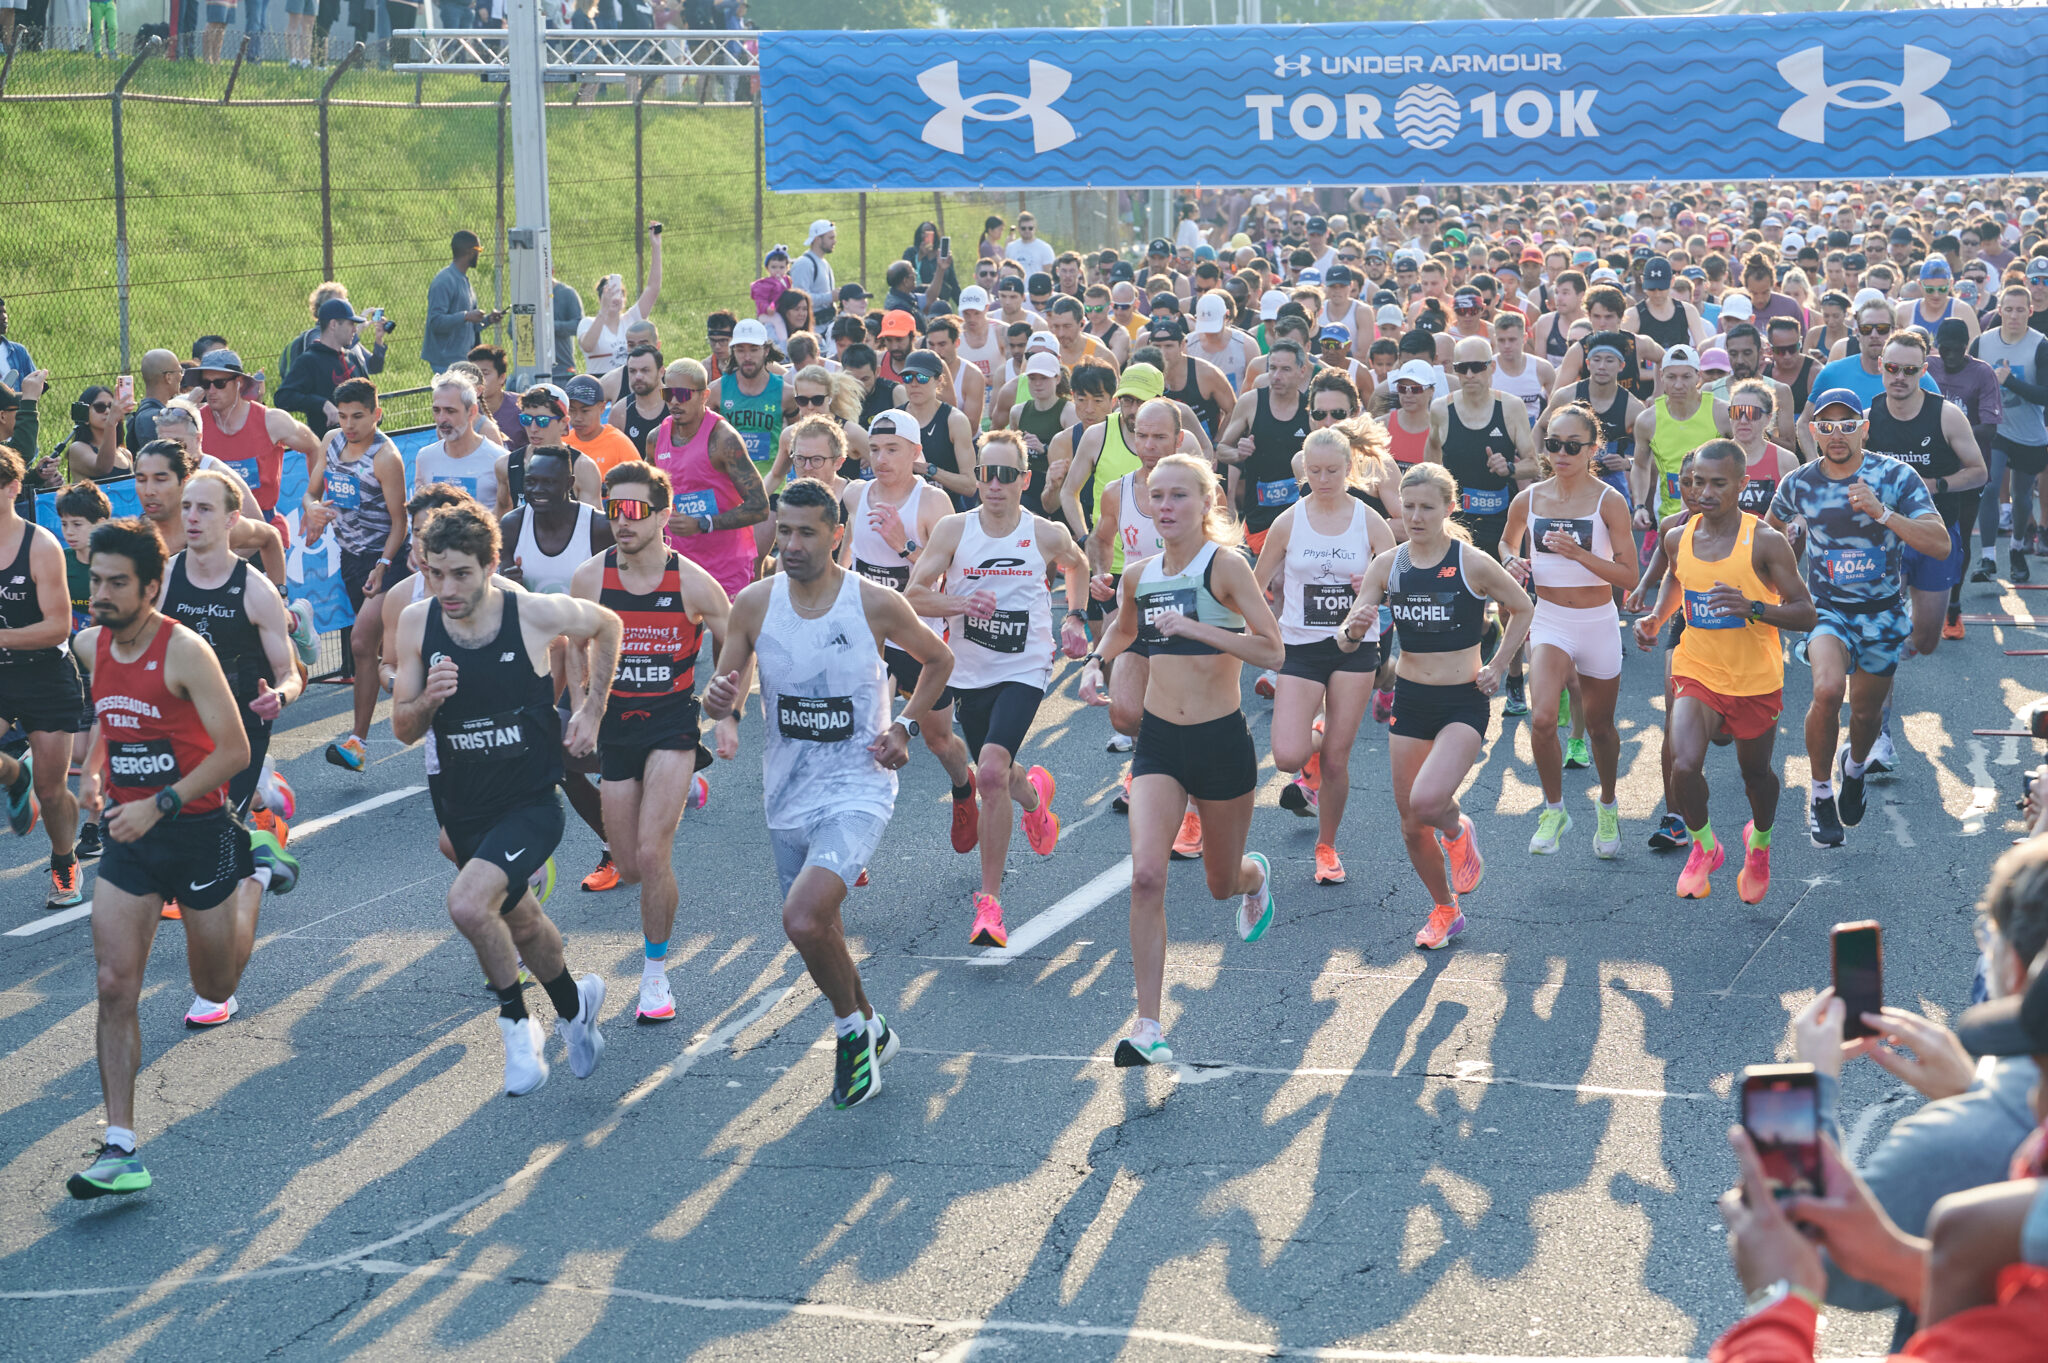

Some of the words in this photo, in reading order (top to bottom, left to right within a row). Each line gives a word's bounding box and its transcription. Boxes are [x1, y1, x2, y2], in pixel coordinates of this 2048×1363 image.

[1322, 55, 1423, 74] UNDER
[1429, 53, 1561, 73] ARMOUR
[1245, 93, 1385, 141] TOR
[1470, 89, 1600, 139] 10K
[328, 480, 356, 496] 4586
[1267, 488, 1288, 500] 430
[678, 500, 707, 514] 2128
[1472, 497, 1502, 508] 3885
[963, 567, 1033, 577] playmakers
[1835, 559, 1876, 574] 4044
[1392, 605, 1451, 621] RACHEL
[967, 615, 1027, 636] BRENT
[106, 714, 141, 729] TRACK
[781, 709, 851, 730] BAGHDAD
[447, 725, 521, 750] TRISTAN
[111, 754, 175, 774] SERGIO
